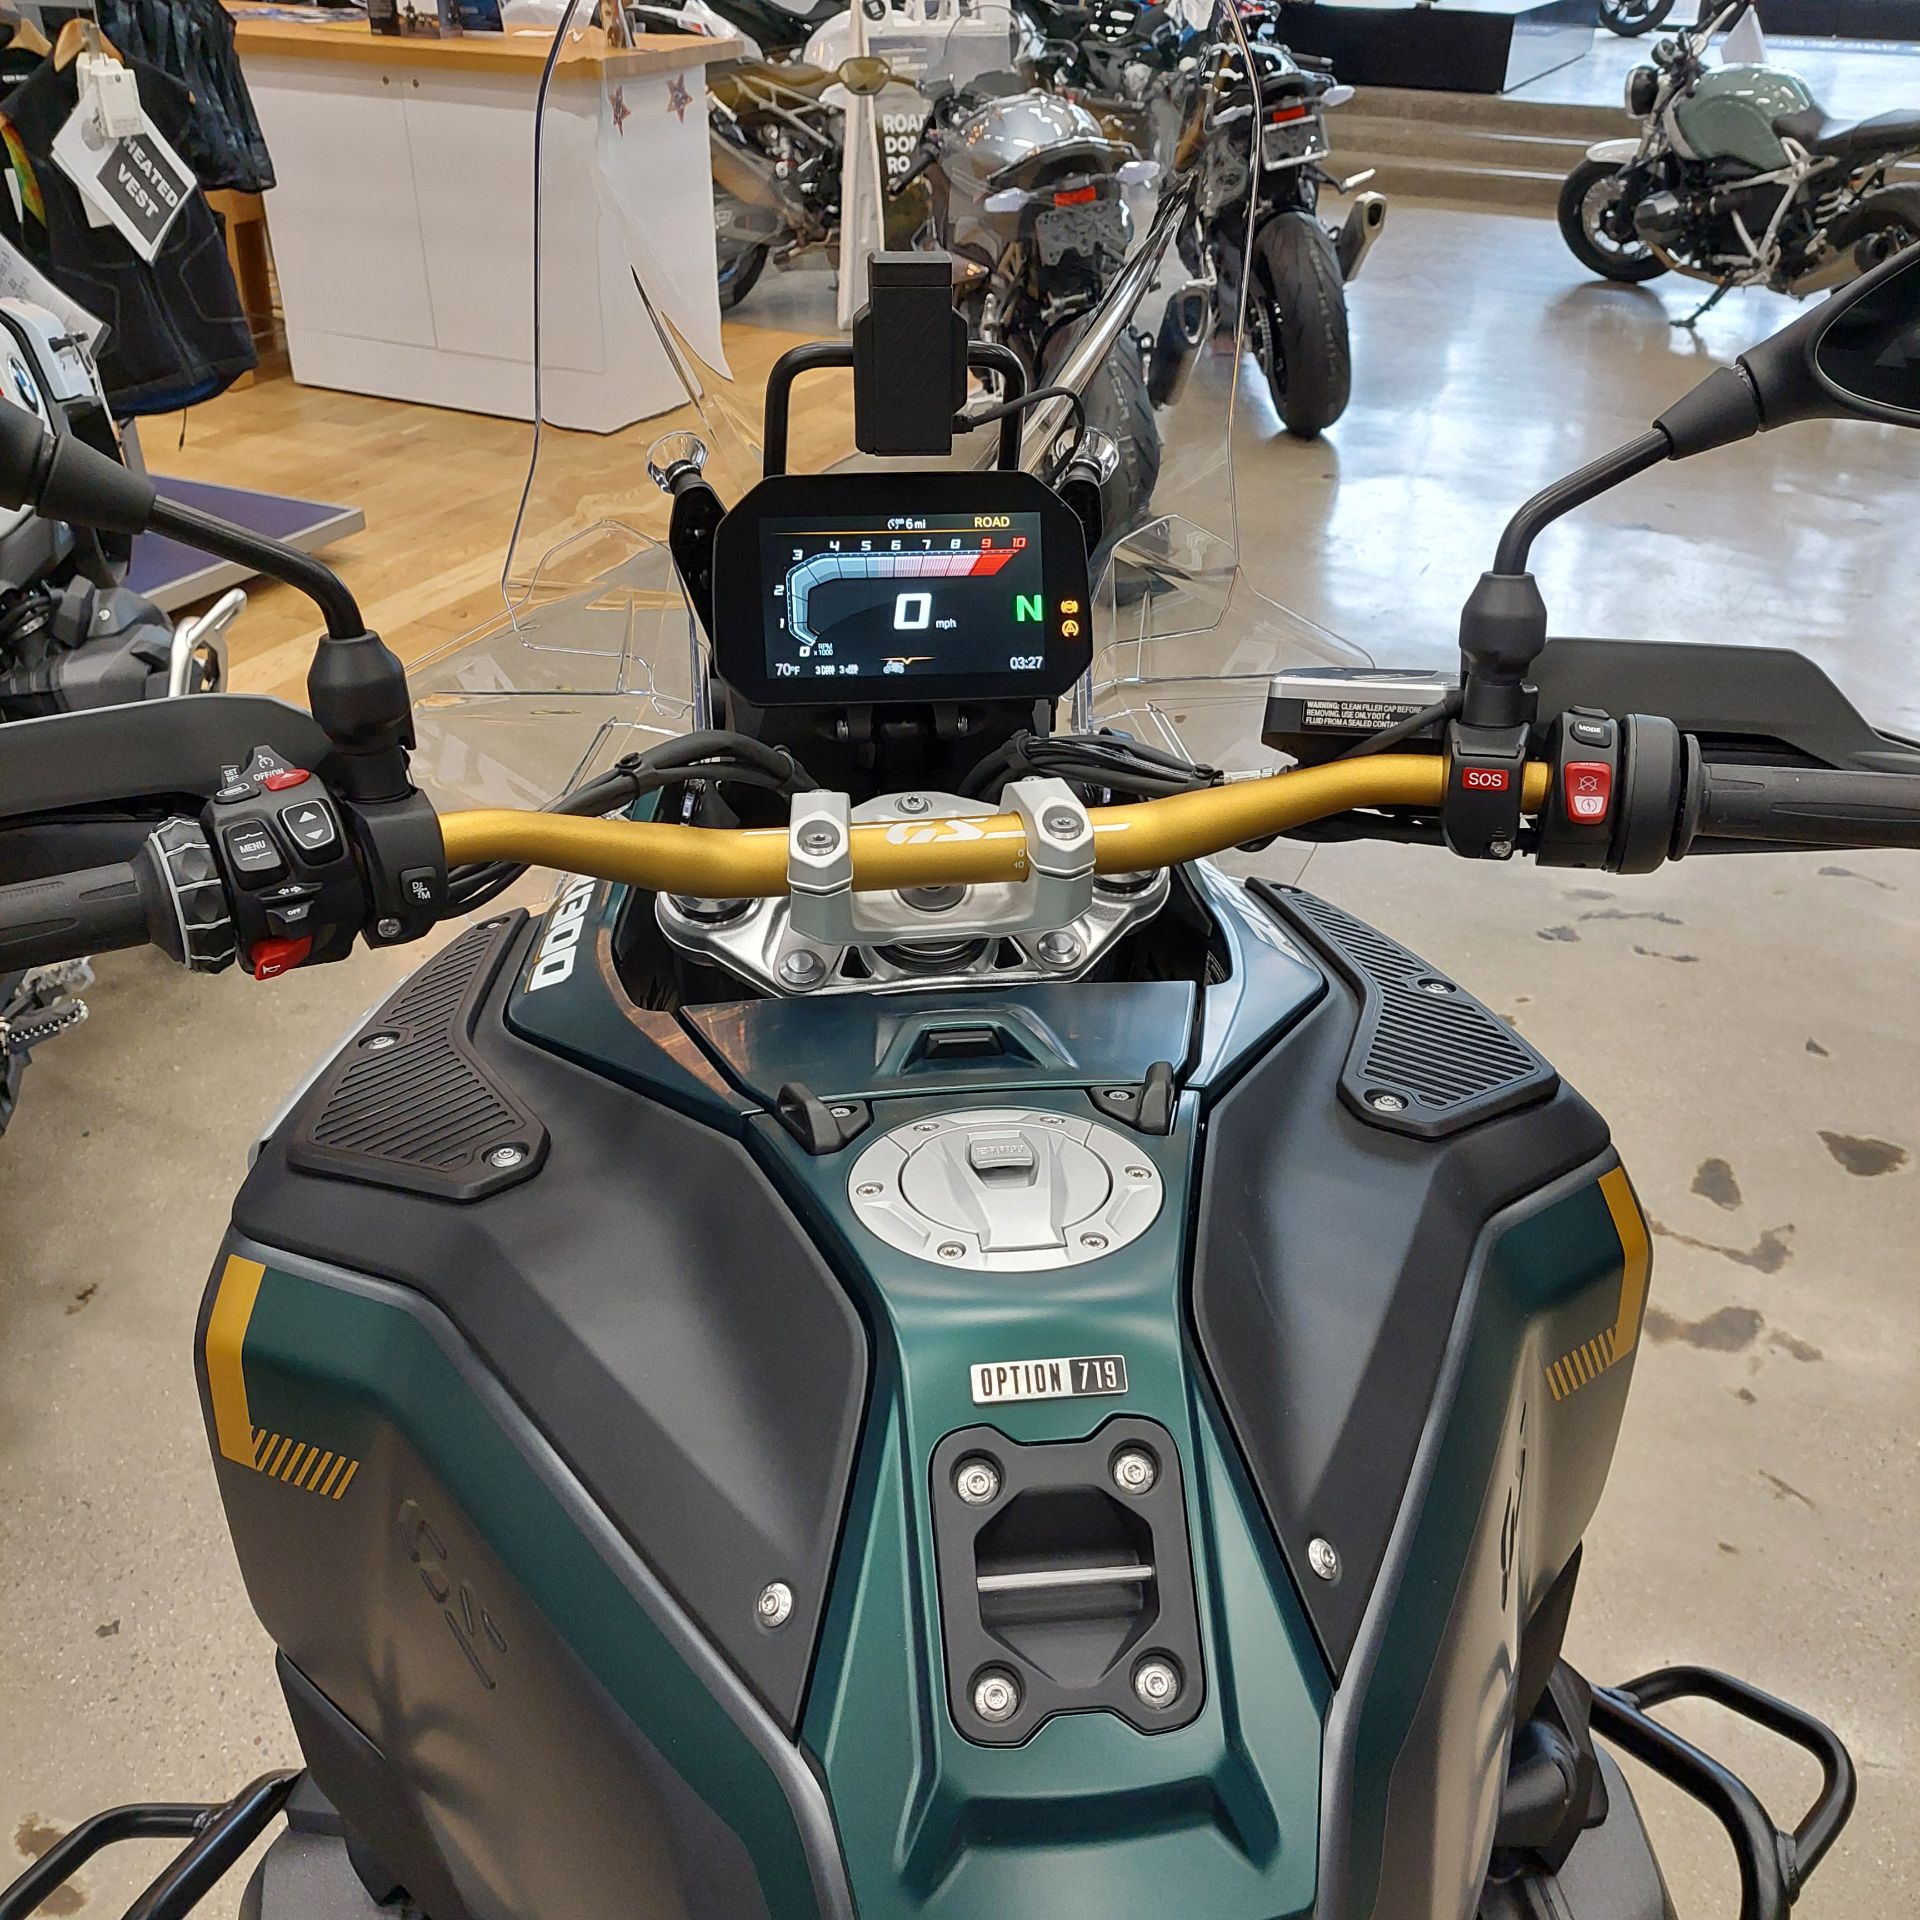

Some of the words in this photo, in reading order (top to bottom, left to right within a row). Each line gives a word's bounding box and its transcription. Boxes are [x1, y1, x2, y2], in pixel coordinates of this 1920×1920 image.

[122, 136, 179, 208] HEATED
[117, 162, 159, 218] VEST
[974, 516, 1010, 528] ROAD
[829, 540, 840, 552] 4
[861, 540, 872, 551] 5
[891, 539, 902, 551] 6
[922, 539, 932, 550] 7
[950, 538, 961, 549] 8
[981, 538, 992, 549] 9
[1012, 537, 1027, 548] 10
[792, 549, 804, 561] 3
[773, 584, 785, 596] 2
[893, 592, 932, 630] 0
[935, 618, 957, 630] mph
[1016, 594, 1043, 622] N
[779, 617, 785, 629] 1
[799, 646, 811, 657] 0
[1009, 655, 1043, 670] 03:27
[1307, 701, 1340, 710] WARNING:
[1341, 703, 1362, 711] CLEAN
[1362, 704, 1384, 712] FILLER
[1384, 705, 1397, 713] CAP
[1396, 706, 1423, 714] BEFORE
[1306, 717, 1323, 725] FLUID
[1323, 718, 1343, 726] FROM
[1371, 712, 1386, 720] DOT
[1578, 724, 1602, 733] MODE
[224, 768, 238, 777] SET
[1468, 772, 1503, 787] SOS
[240, 840, 267, 853] MENU
[287, 907, 302, 917] OFF
[980, 1362, 1062, 1397] OPTION
[1078, 1360, 1118, 1391] 719
